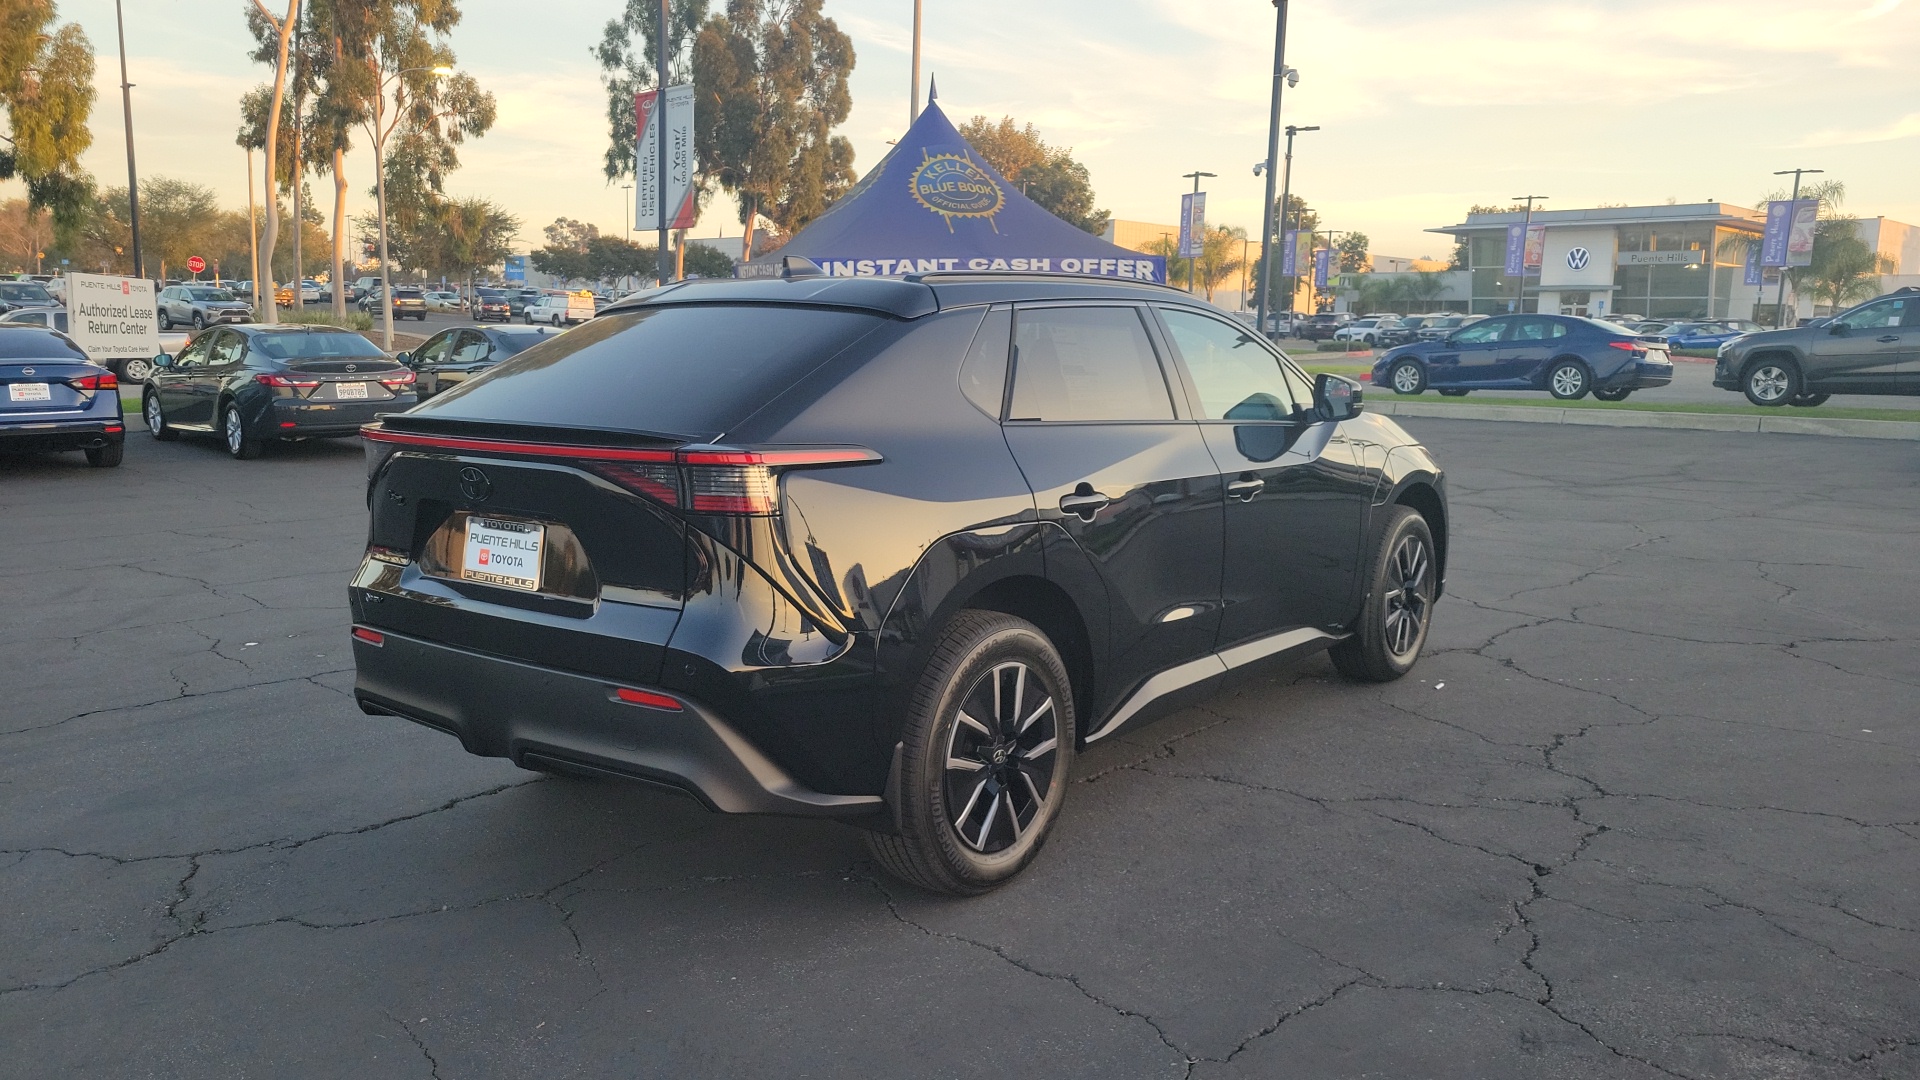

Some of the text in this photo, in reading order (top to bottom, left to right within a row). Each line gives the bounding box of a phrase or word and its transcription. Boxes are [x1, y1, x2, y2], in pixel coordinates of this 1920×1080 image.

[673, 128, 681, 184] 7 Year/
[924, 161, 985, 181] KELLEY
[920, 181, 995, 196] BLUE BOOK
[932, 196, 991, 210] OFFICIAL GUIDE
[188, 260, 204, 269] STOP
[1631, 253, 1688, 263] Puente Hills
[759, 263, 774, 276] CASH
[822, 258, 1154, 281] INSTANT CASH OFFER
[81, 281, 147, 293] PUENTE HILLS TOYOTA
[79, 303, 153, 319] Authorized Lease
[88, 320, 147, 335] Return Center
[88, 345, 101, 353] Claim
[113, 345, 128, 354] Toyota
[484, 519, 525, 532] TOYOTA
[470, 532, 539, 552] PUENTE HILLS
[491, 553, 523, 568] TOYOTA
[464, 570, 534, 589] PUENTE HILLS
[949, 638, 999, 696] TURANZA
[1039, 644, 1073, 739] BRIDGESTONE
